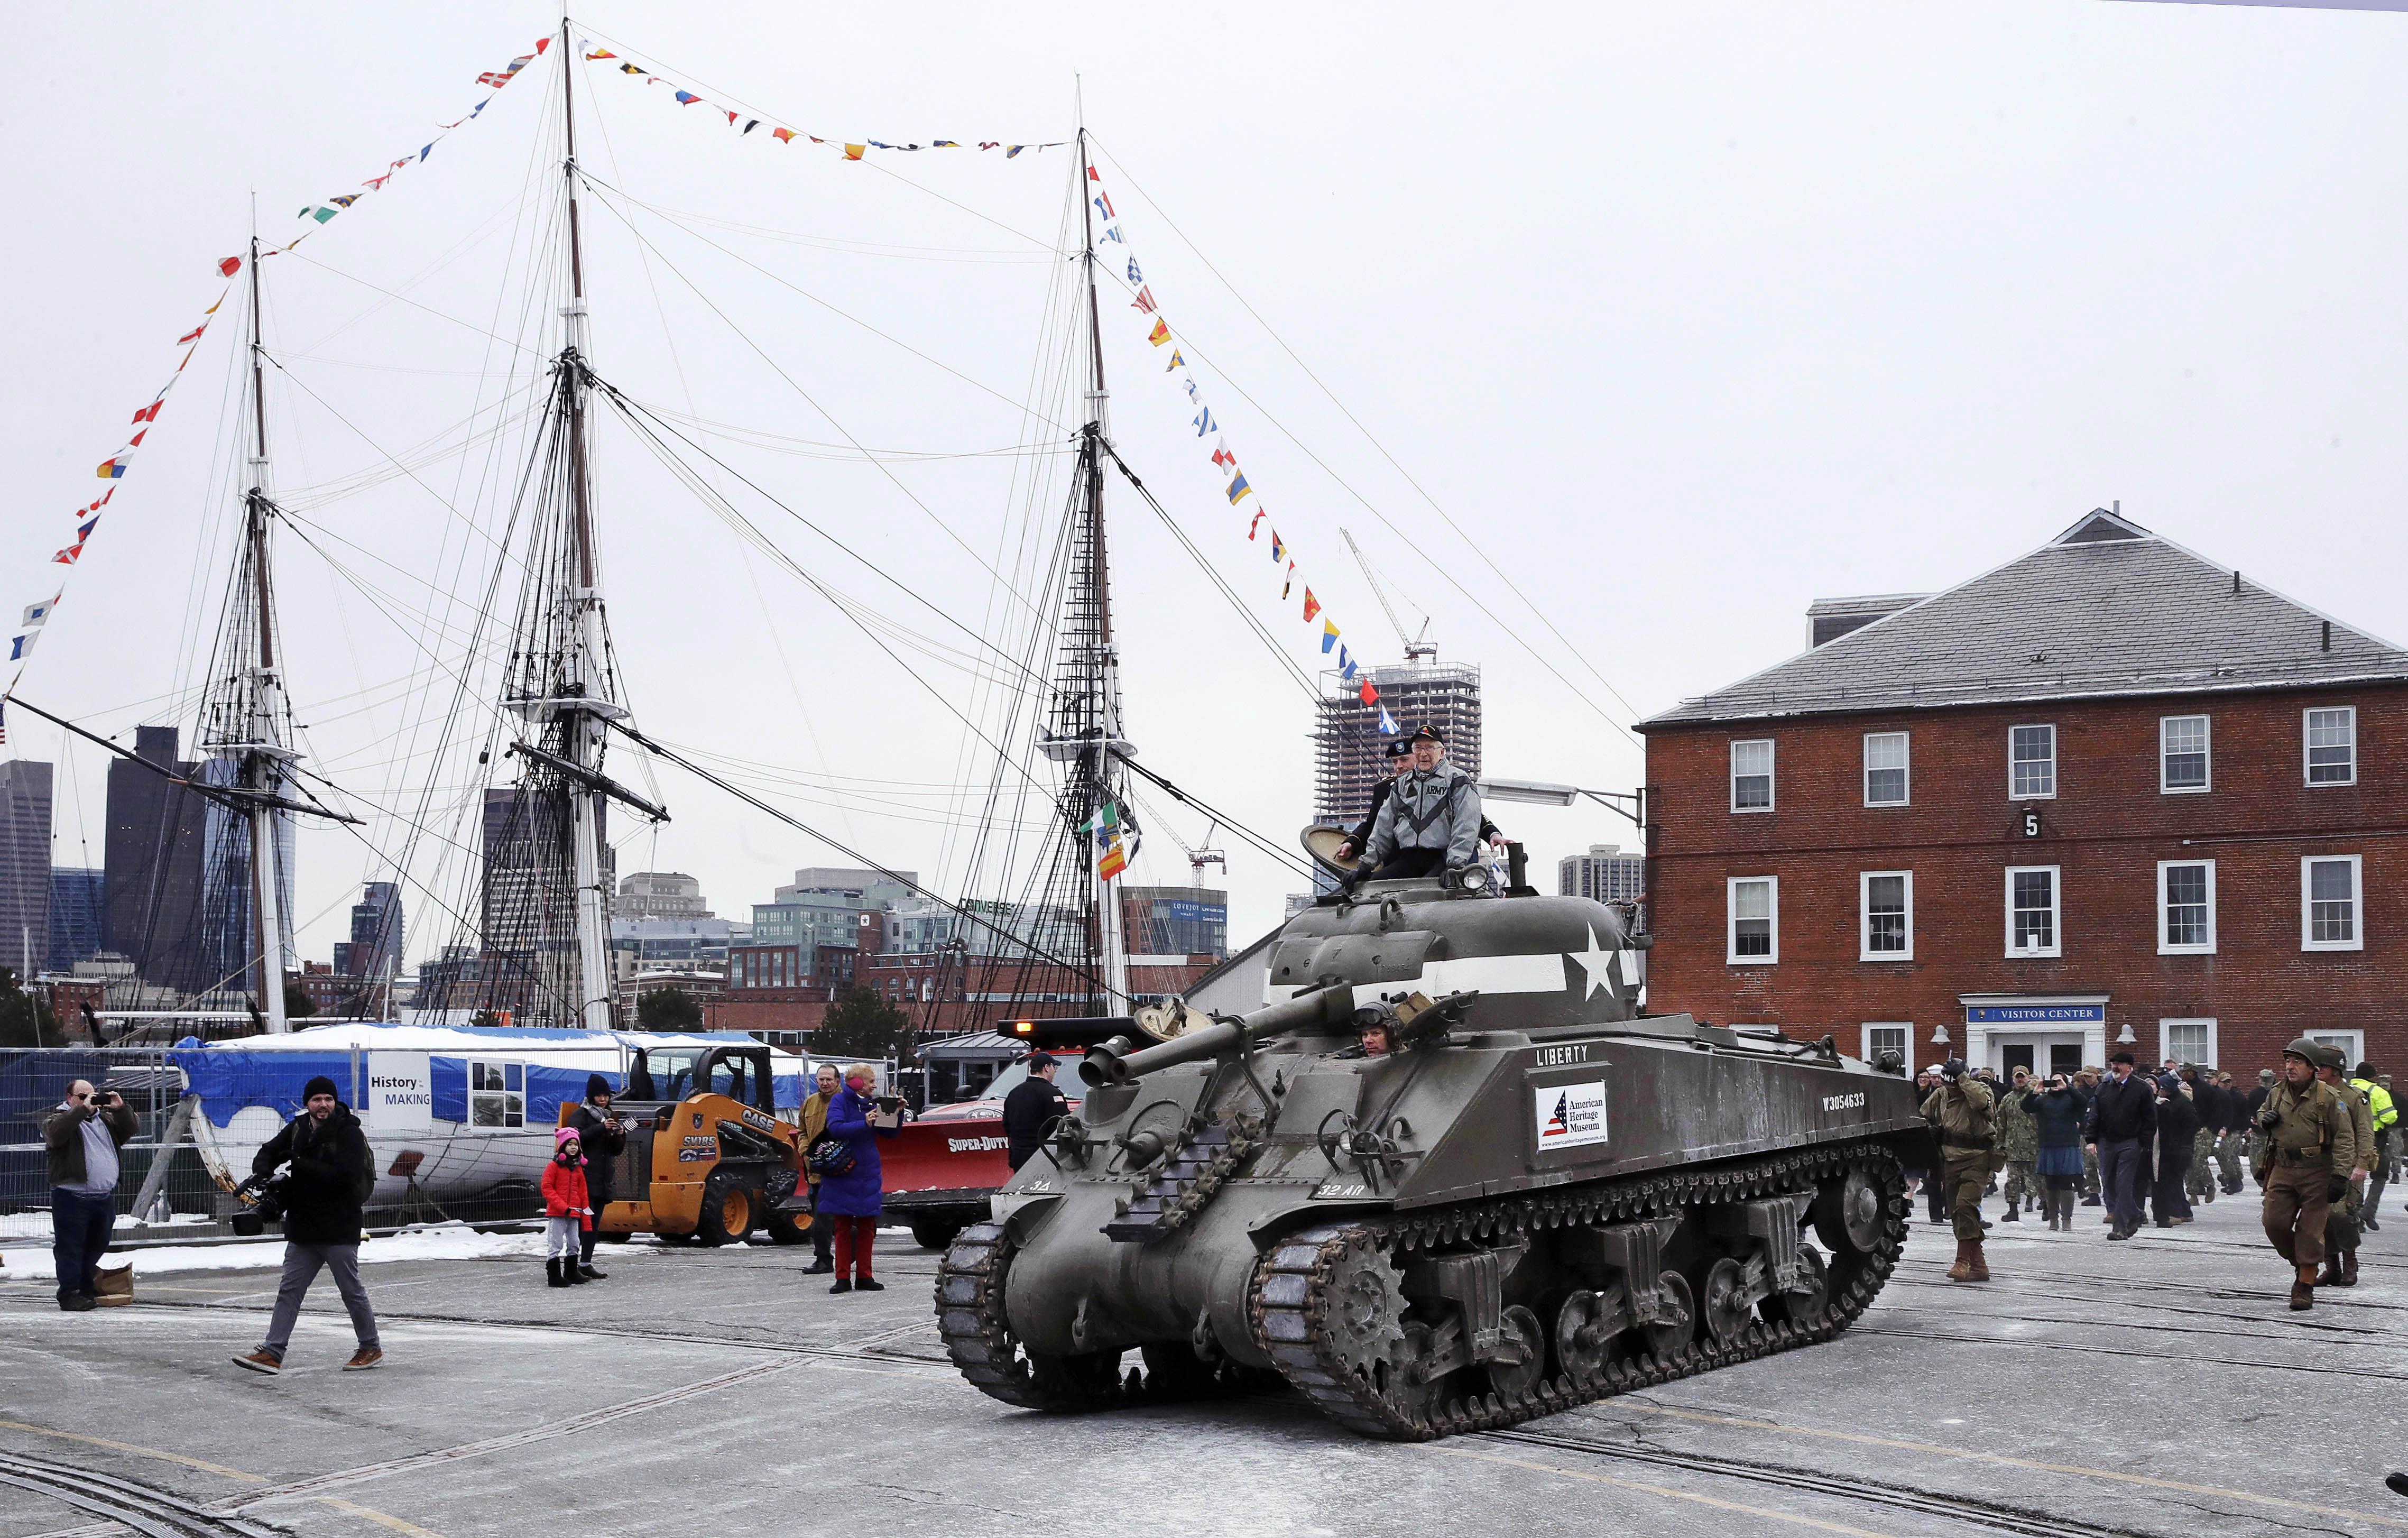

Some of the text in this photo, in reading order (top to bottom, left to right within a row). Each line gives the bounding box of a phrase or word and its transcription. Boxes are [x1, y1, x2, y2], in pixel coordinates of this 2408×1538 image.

[1426, 786, 1447, 795] ARMY
[2026, 815, 2038, 836] 5
[959, 898, 1011, 917] CONVERSE
[1174, 902, 1200, 911] LOVEJOY
[2001, 1009, 2094, 1019] VISITOR CENTER
[1536, 1045, 1588, 1066] LIBERTY
[371, 1076, 417, 1090] History
[385, 1093, 430, 1105] MAKING
[1569, 1098, 1603, 1110] American
[1822, 1092, 1865, 1112] W3054633
[742, 1109, 776, 1133] CASE
[1569, 1110, 1599, 1122] Heritage
[1570, 1122, 1600, 1133] Museum
[684, 1136, 716, 1147] SV185
[1317, 1184, 1342, 1196] 32
